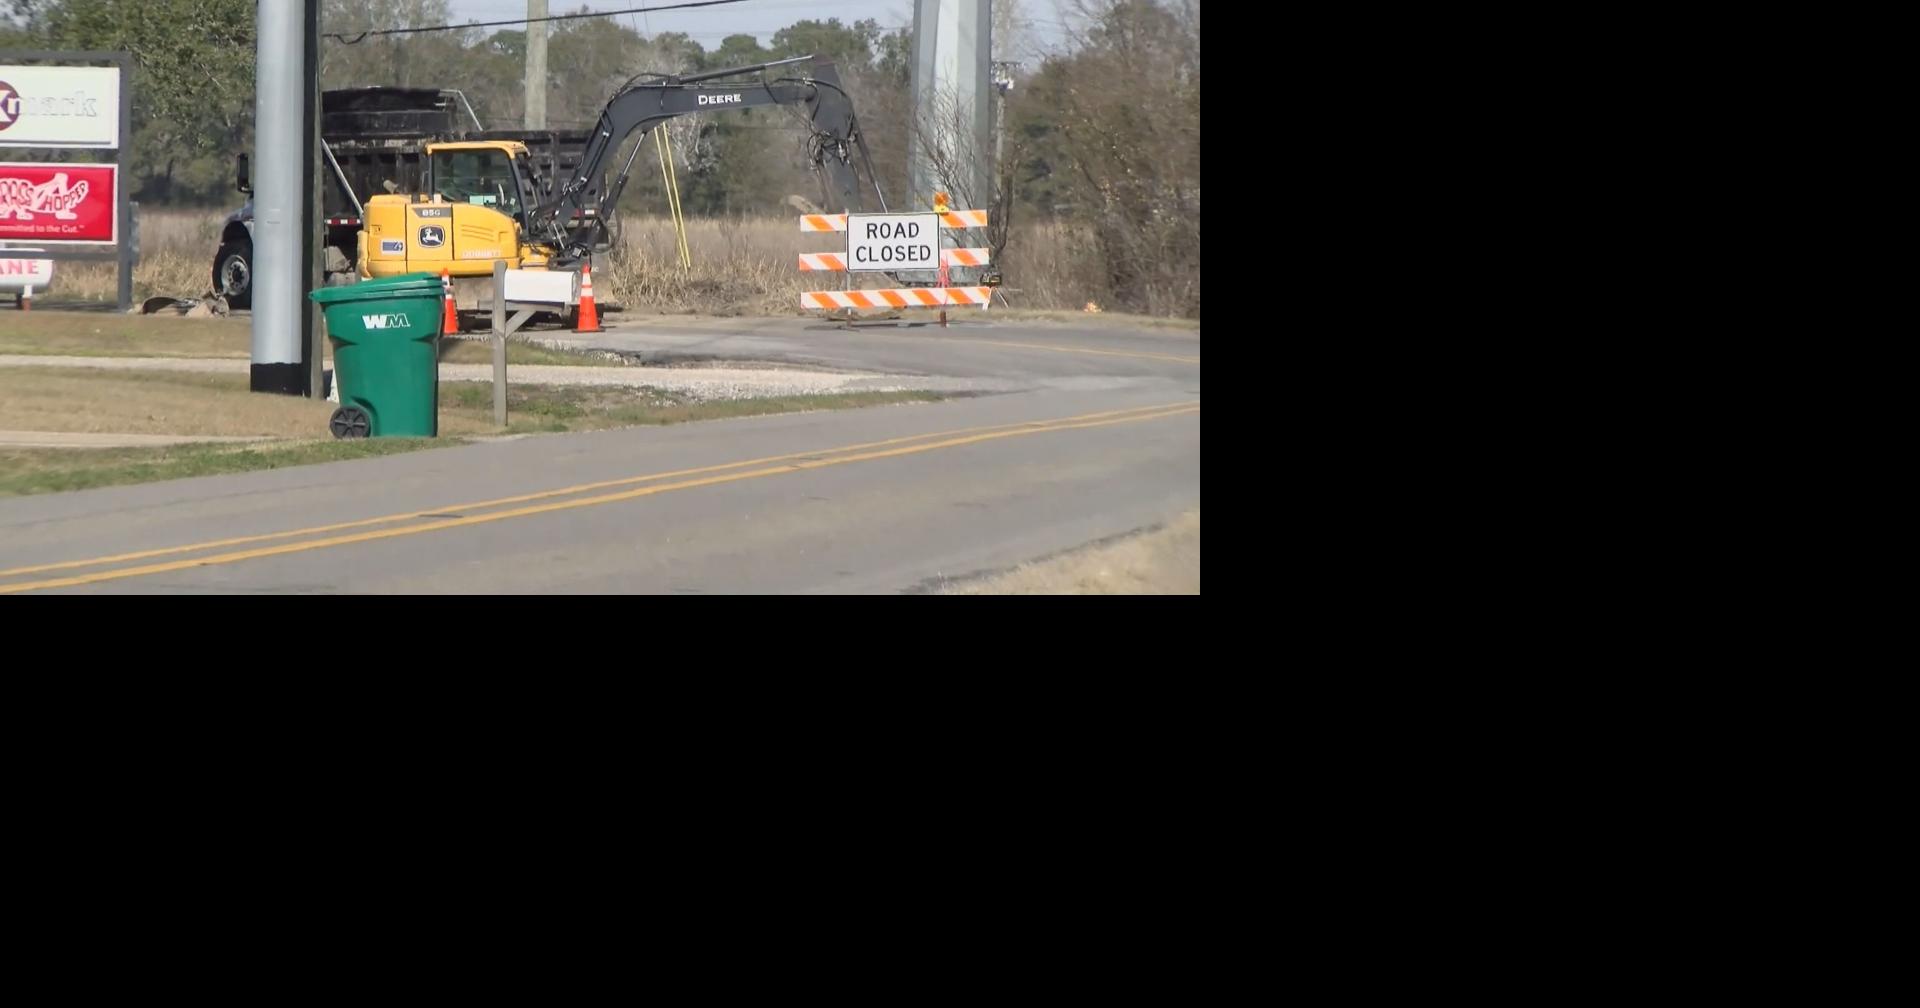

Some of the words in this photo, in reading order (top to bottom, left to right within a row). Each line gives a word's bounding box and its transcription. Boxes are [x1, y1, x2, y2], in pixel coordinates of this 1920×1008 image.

[697, 93, 742, 105] DEERE
[866, 222, 920, 240] ROAD
[855, 245, 931, 263] CLOSED
